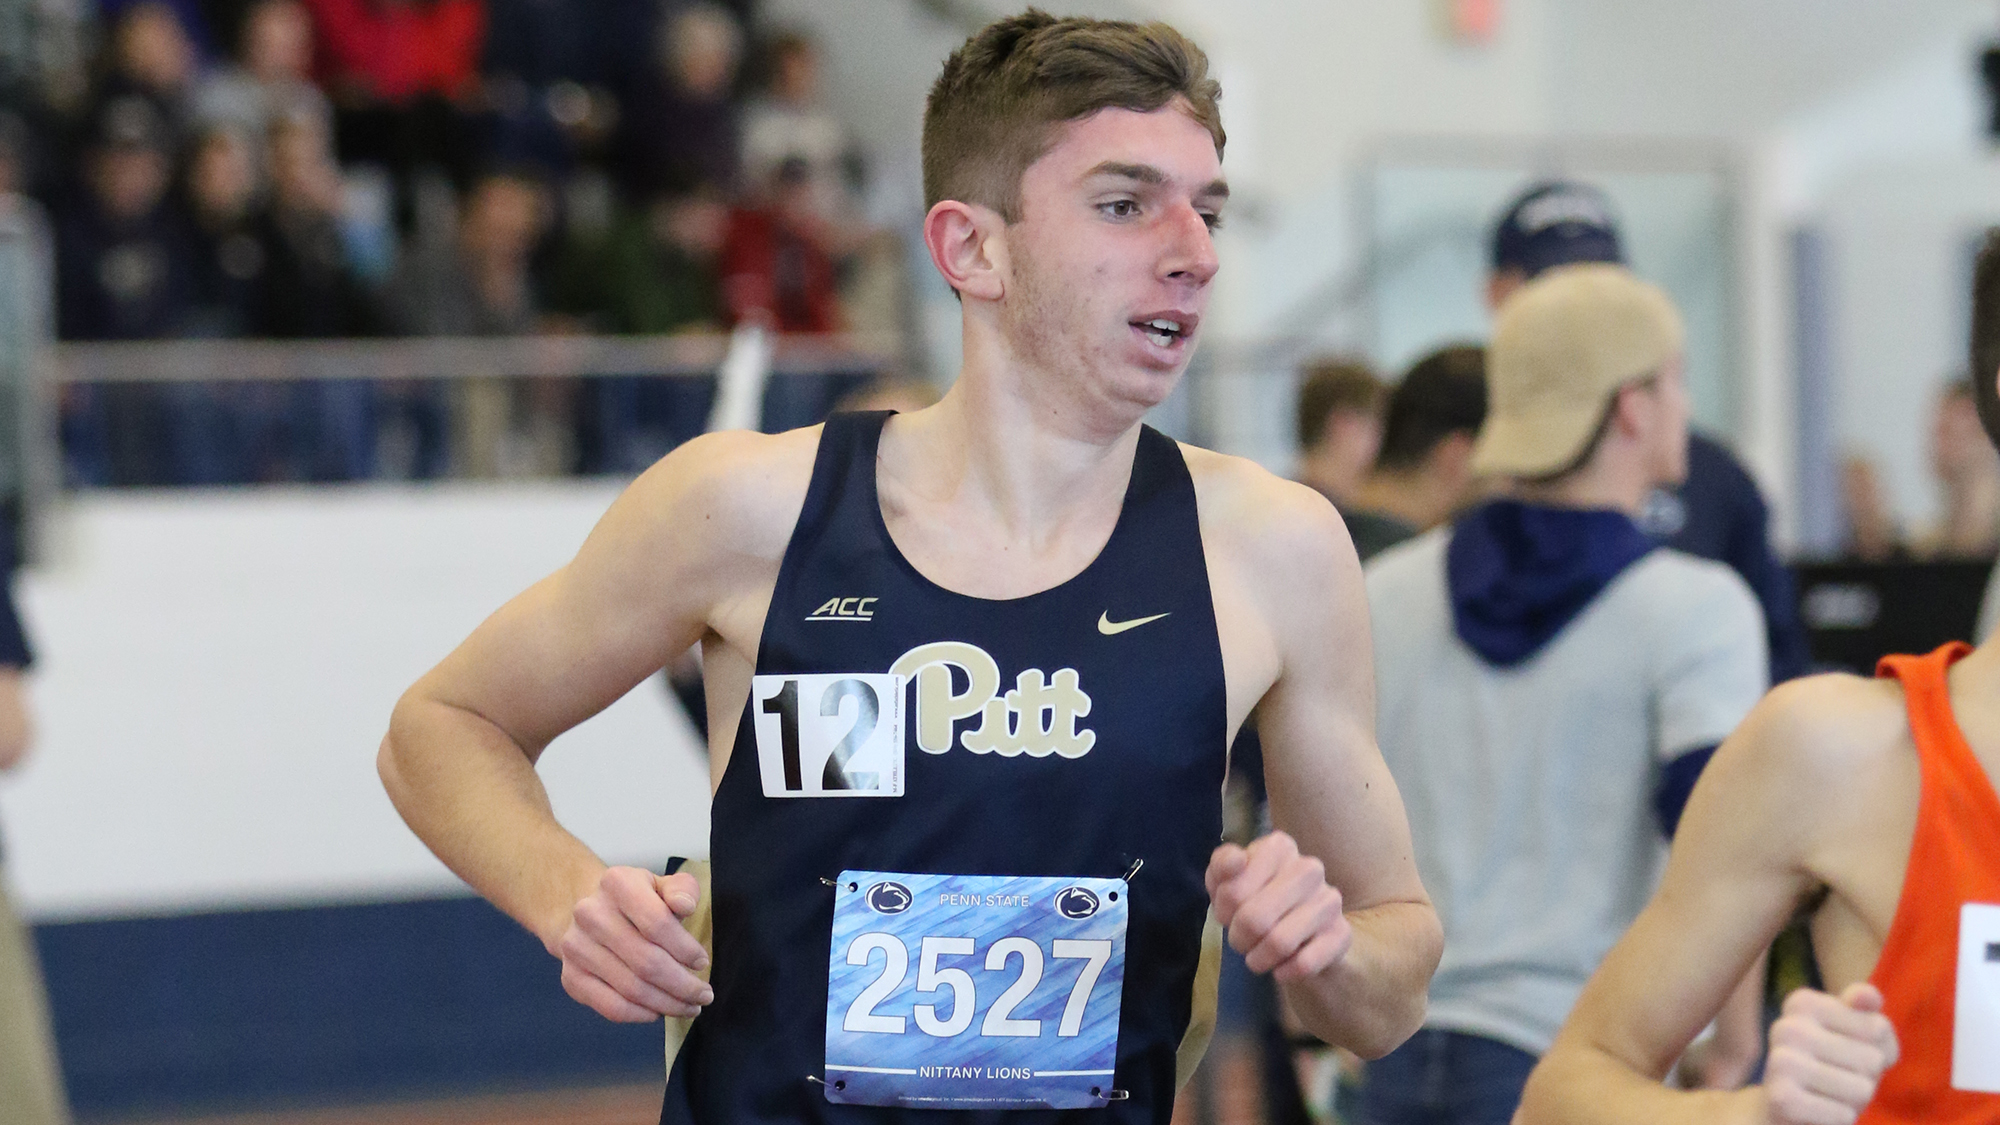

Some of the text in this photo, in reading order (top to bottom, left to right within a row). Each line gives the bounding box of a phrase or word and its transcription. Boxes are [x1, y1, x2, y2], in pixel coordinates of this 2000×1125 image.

[811, 596, 879, 617] ACC
[887, 641, 1097, 759] Pitt
[762, 678, 880, 791] 12
[939, 893, 1030, 908] PENN STATE
[842, 931, 1113, 1038] 2527
[919, 1066, 1032, 1080] NITTANY LIONS
